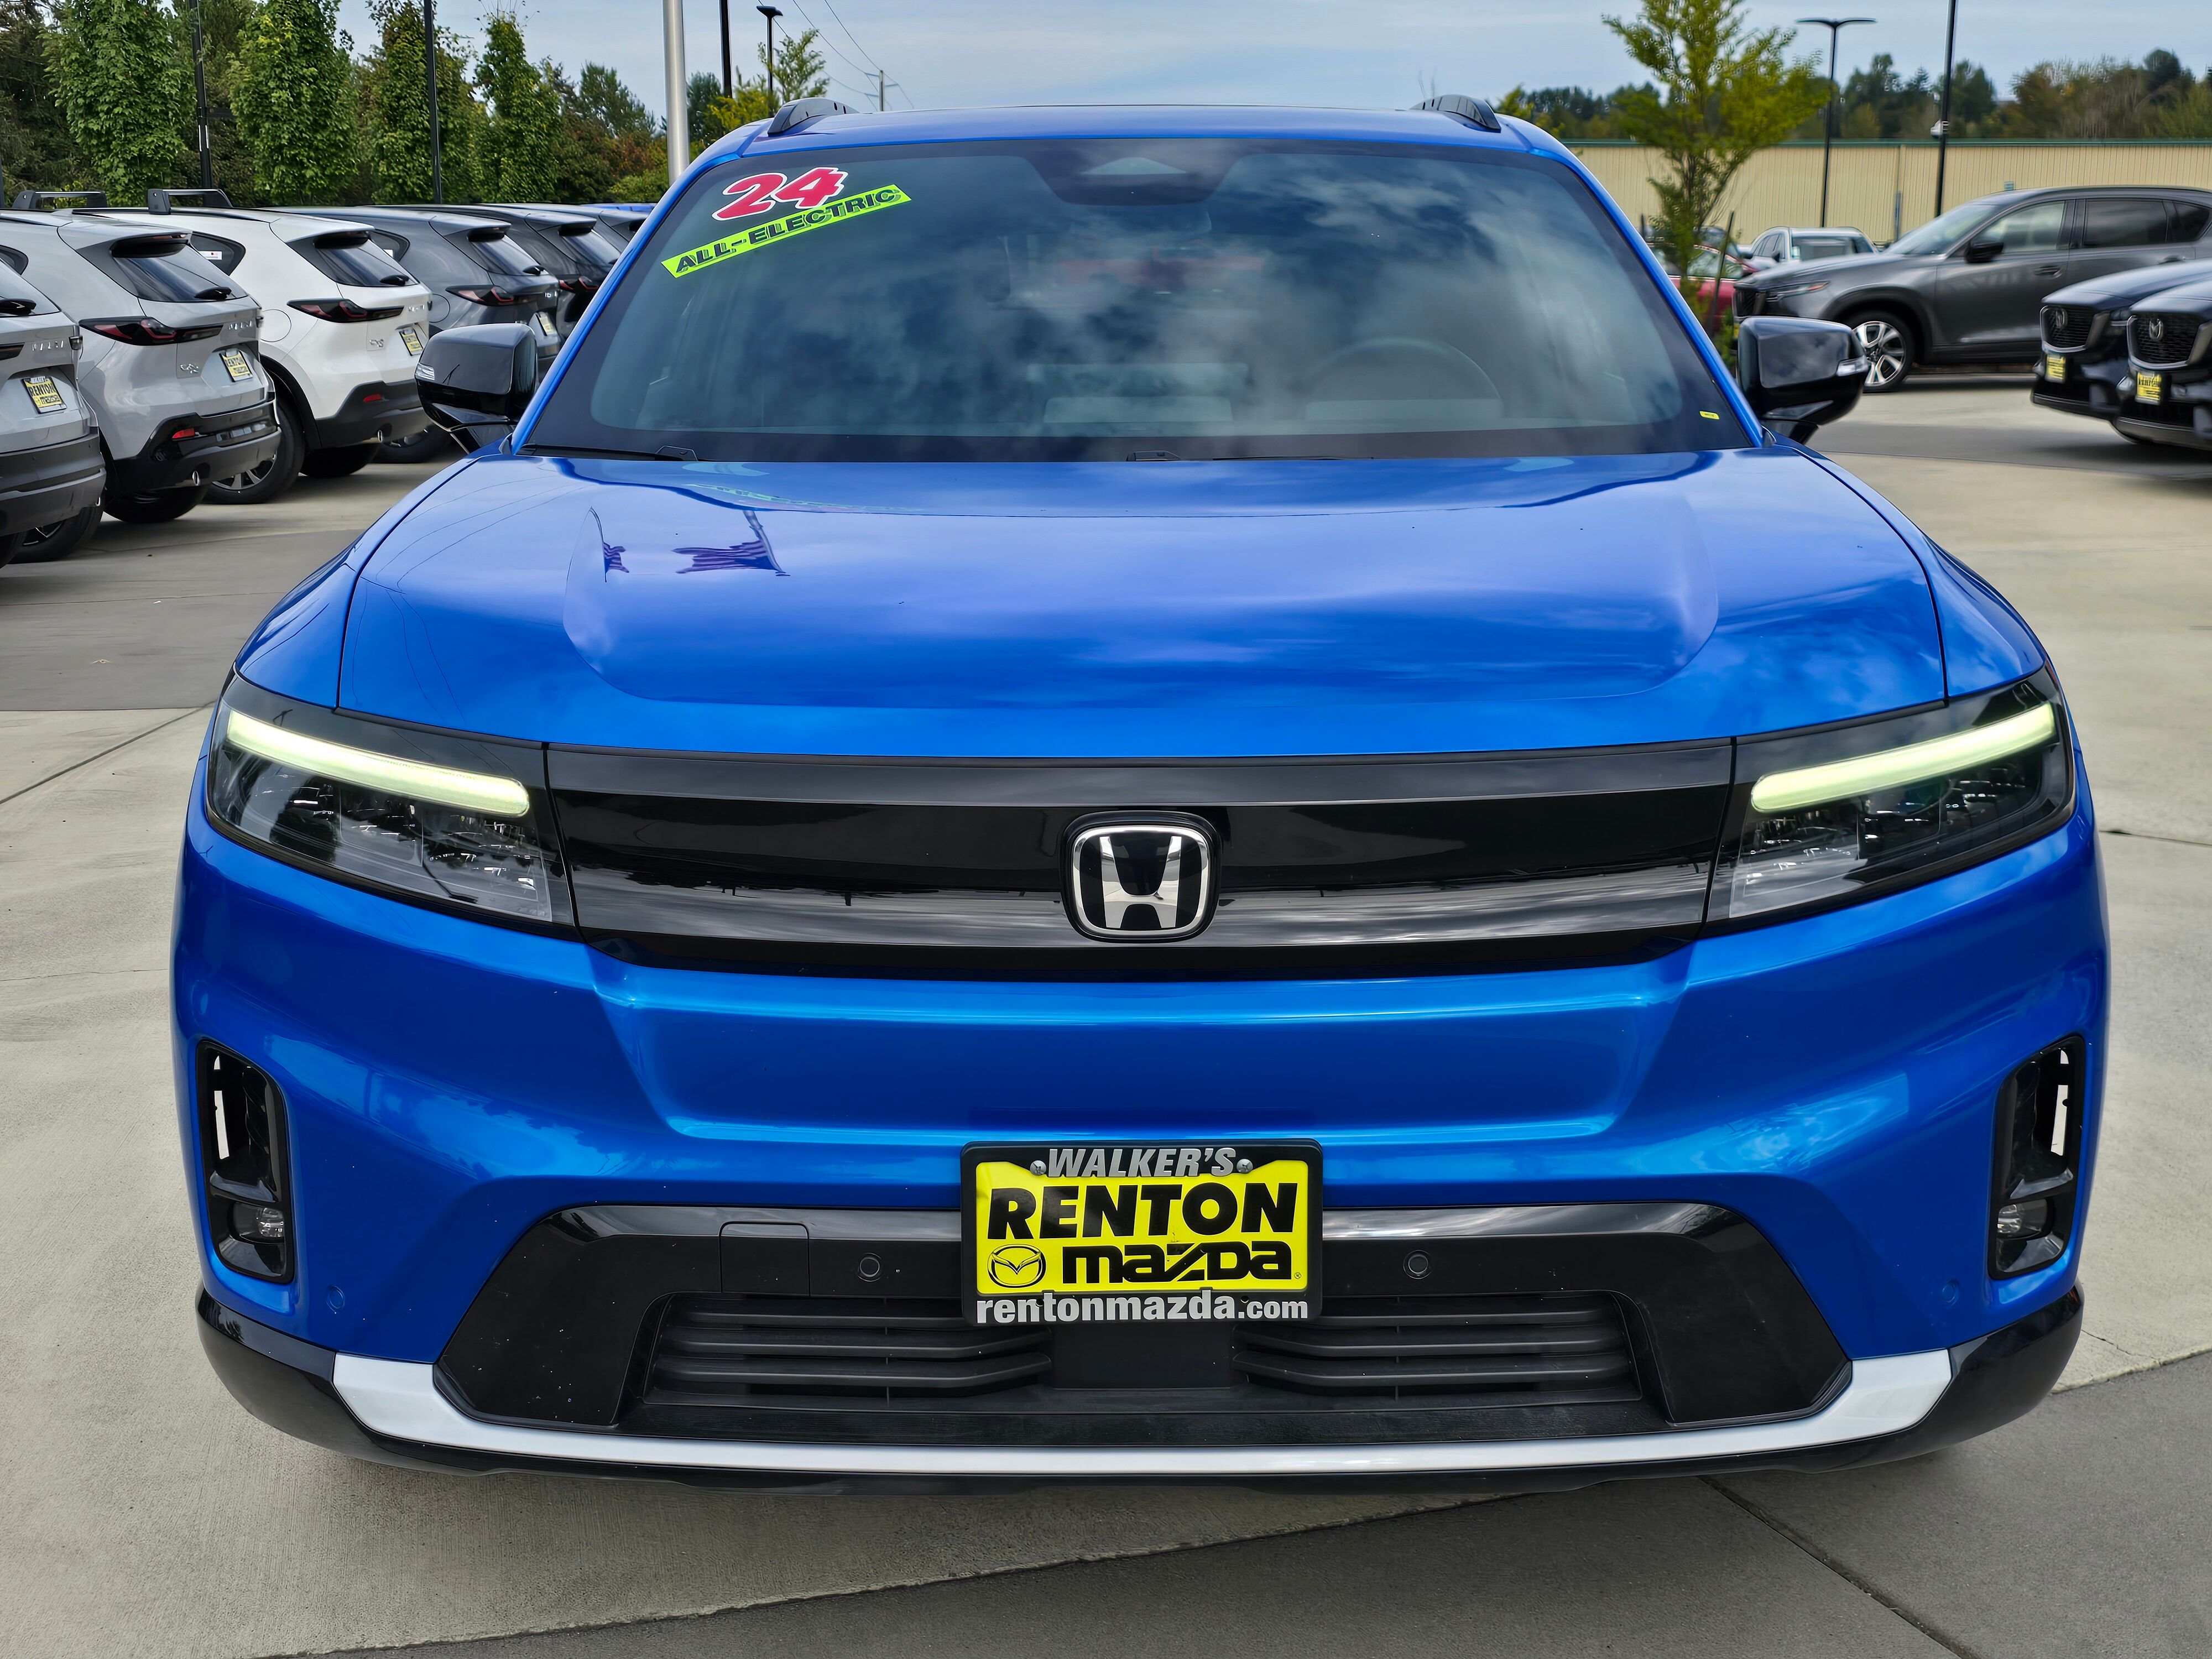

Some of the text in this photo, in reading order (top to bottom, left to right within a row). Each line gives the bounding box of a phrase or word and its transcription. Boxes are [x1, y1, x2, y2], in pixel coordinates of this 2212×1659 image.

[712, 167, 848, 221] 24
[676, 189, 901, 273] ALL-ELECTRIC
[1048, 1147, 1237, 1178] WALKER'S
[987, 1182, 1298, 1240] RENTON
[1062, 1241, 1292, 1284] mazda
[977, 1290, 1308, 1323] rentonmazda.com
